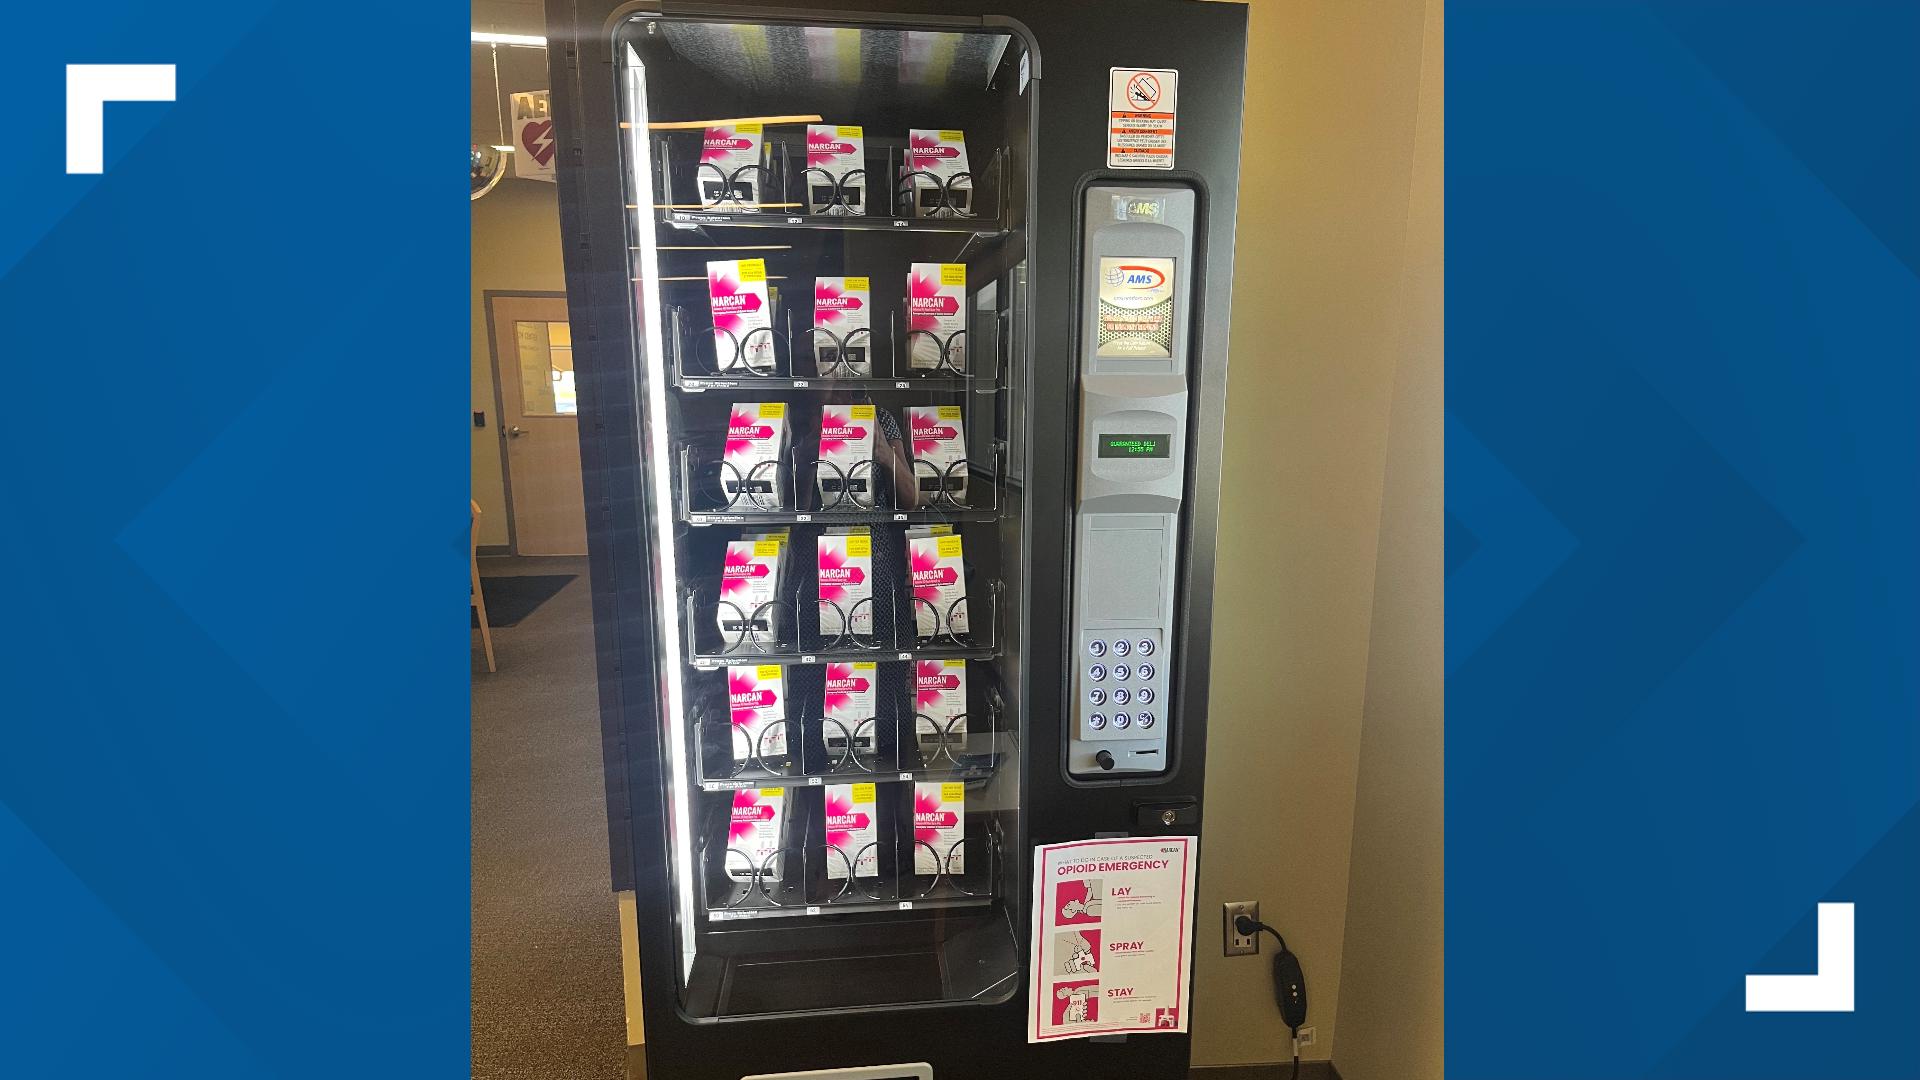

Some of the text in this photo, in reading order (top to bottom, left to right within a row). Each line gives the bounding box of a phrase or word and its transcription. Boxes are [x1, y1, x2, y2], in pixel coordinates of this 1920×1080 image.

[518, 93, 550, 120] AE
[704, 139, 738, 147] NARCAN
[809, 143, 841, 151] NARCAN
[913, 147, 945, 155] NARCAN
[1127, 275, 1152, 284] AMS
[712, 295, 746, 307] NARCAN
[816, 298, 848, 307] NARCAN
[912, 297, 944, 308] NARCAN
[729, 426, 761, 436] NARCAN
[822, 427, 853, 436] NARCAN
[913, 428, 944, 437] NARCAN
[724, 565, 756, 575] NARCAN
[820, 568, 851, 579] NARCAN
[913, 570, 945, 581] NARCAN
[827, 679, 856, 689] NARCAN
[918, 676, 947, 686] NARCAN
[731, 692, 763, 704] NARCAN
[732, 806, 763, 817] NARCAN
[827, 815, 857, 826] NARCAN
[915, 812, 946, 823] NARCAN
[1057, 860, 1169, 876] OPIOID EMERGENCY
[1111, 887, 1131, 896] LAY
[1109, 941, 1144, 951] SPRAY
[1107, 987, 1134, 998] STAY
